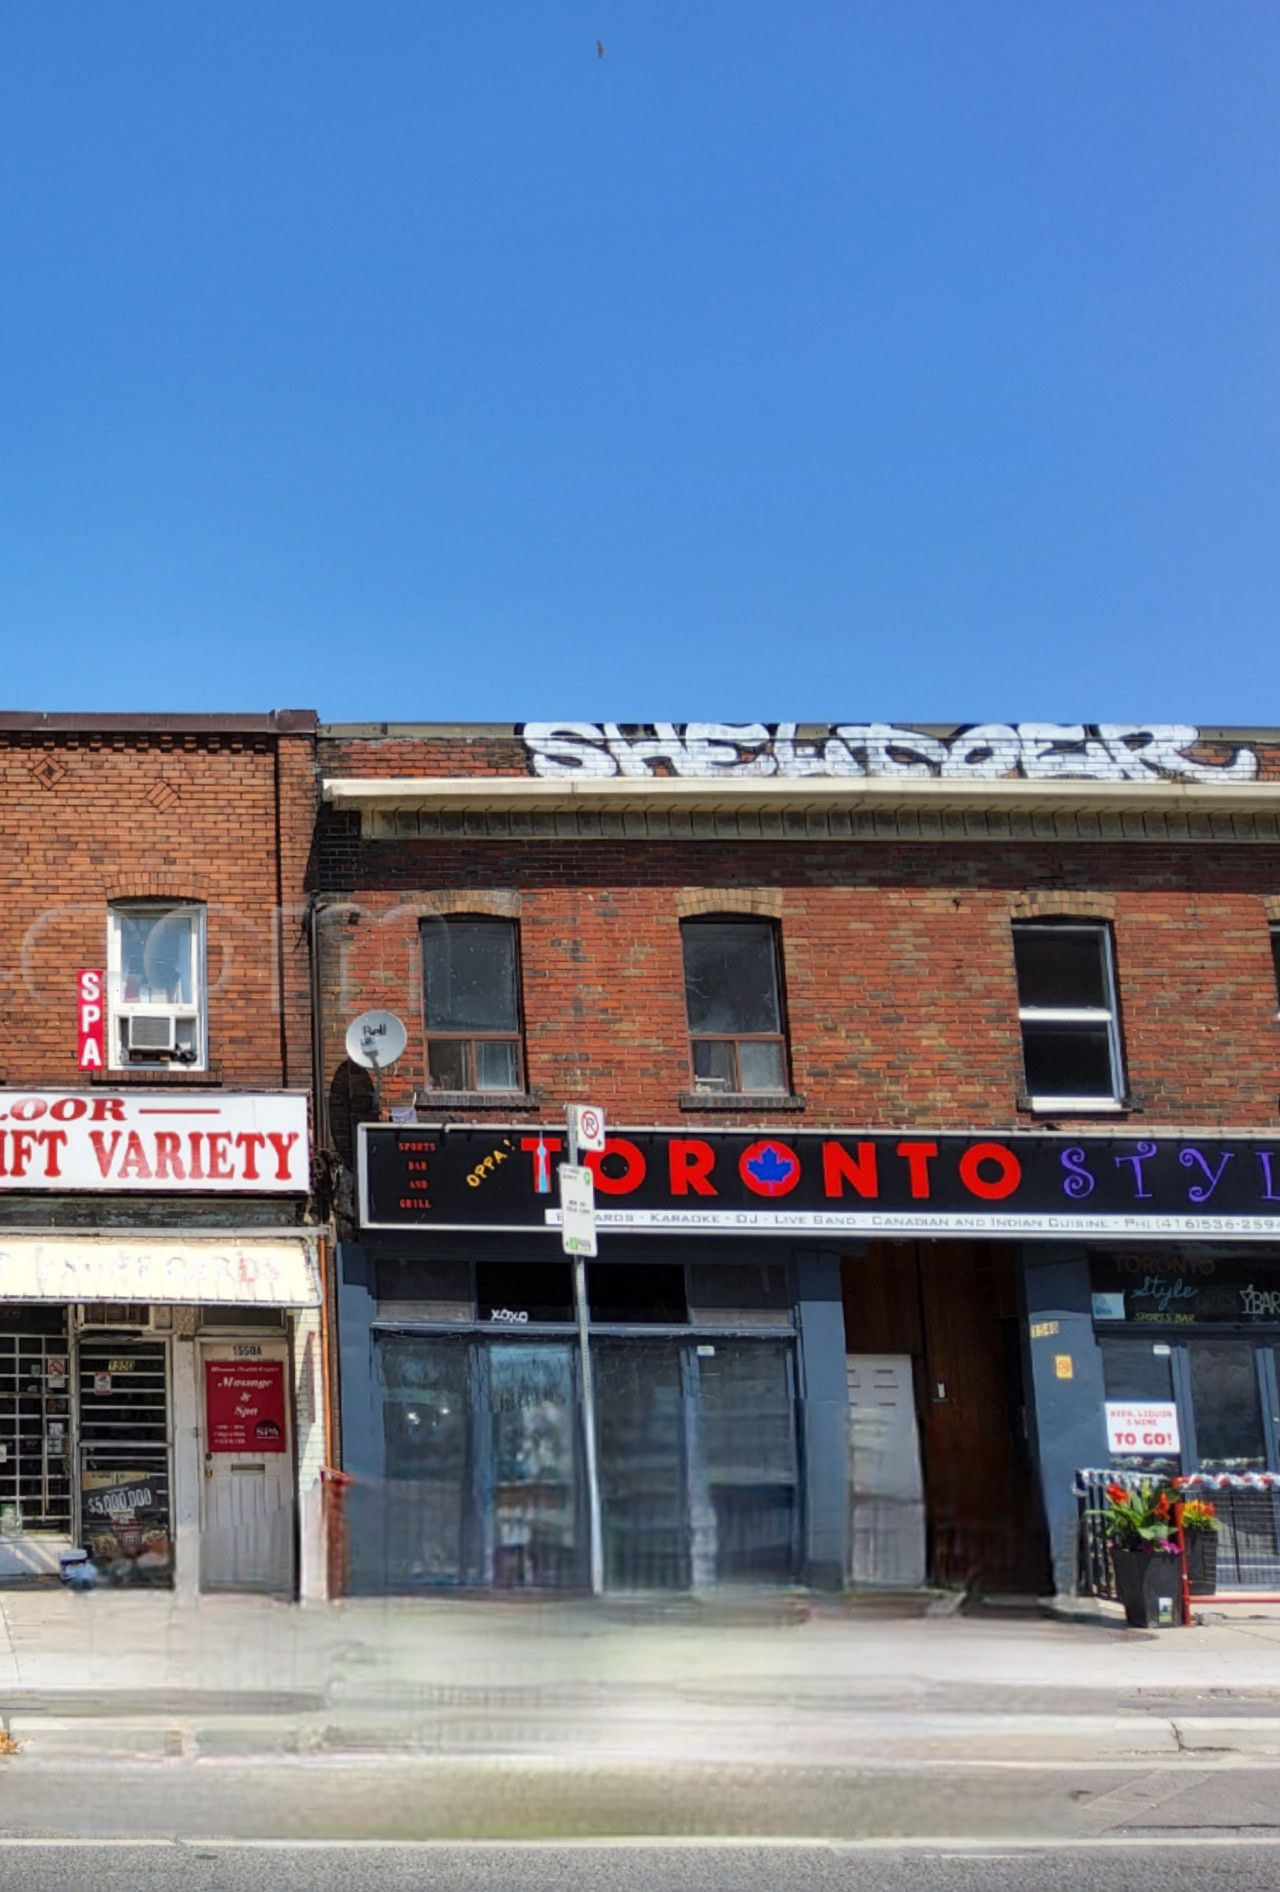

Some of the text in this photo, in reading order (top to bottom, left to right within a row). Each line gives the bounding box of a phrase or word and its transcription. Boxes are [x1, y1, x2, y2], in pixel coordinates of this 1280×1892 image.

[80, 972, 102, 1067] SPA
[398, 1142, 437, 1152] SPORTS
[89, 1131, 300, 1181] VARIETY
[407, 1160, 428, 1171] BAR
[521, 1137, 1022, 1200] TORONTO
[399, 1199, 433, 1209] GRILL
[1156, 1218, 1280, 1231] (416)536-259
[1130, 1276, 1199, 1312] Style
[218, 1376, 274, 1389] Massage
[234, 1405, 258, 1418] Spa
[1114, 1432, 1173, 1446] TO GO!
